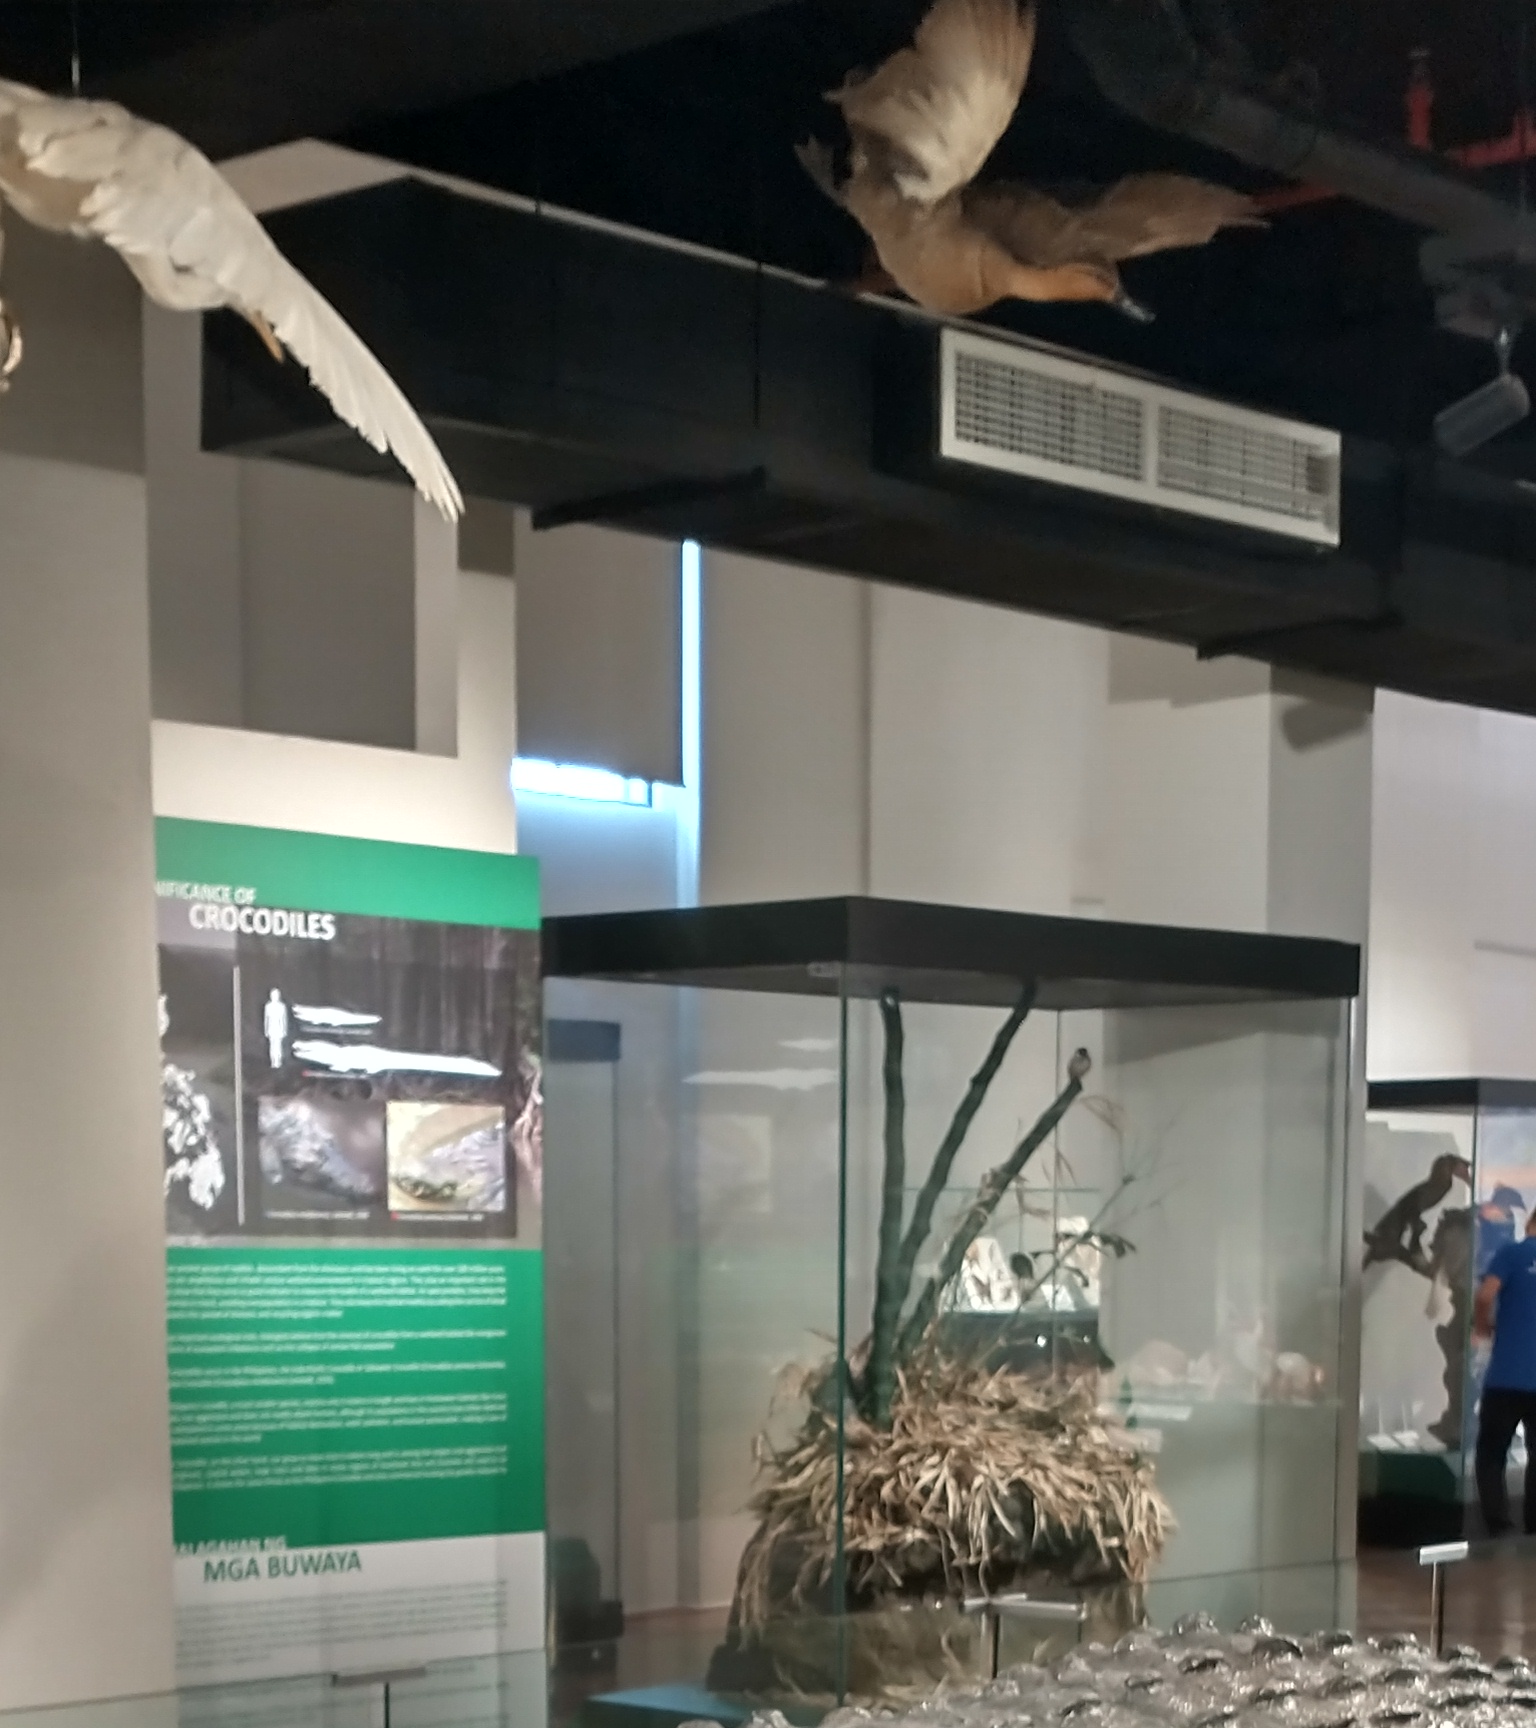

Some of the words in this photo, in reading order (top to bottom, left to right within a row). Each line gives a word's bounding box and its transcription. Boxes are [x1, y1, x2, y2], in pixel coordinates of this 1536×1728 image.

[234, 886, 256, 905] OF
[188, 903, 336, 940] CROCODILES
[204, 1557, 260, 1582] MGA
[268, 1551, 362, 1578] BUWAYA
